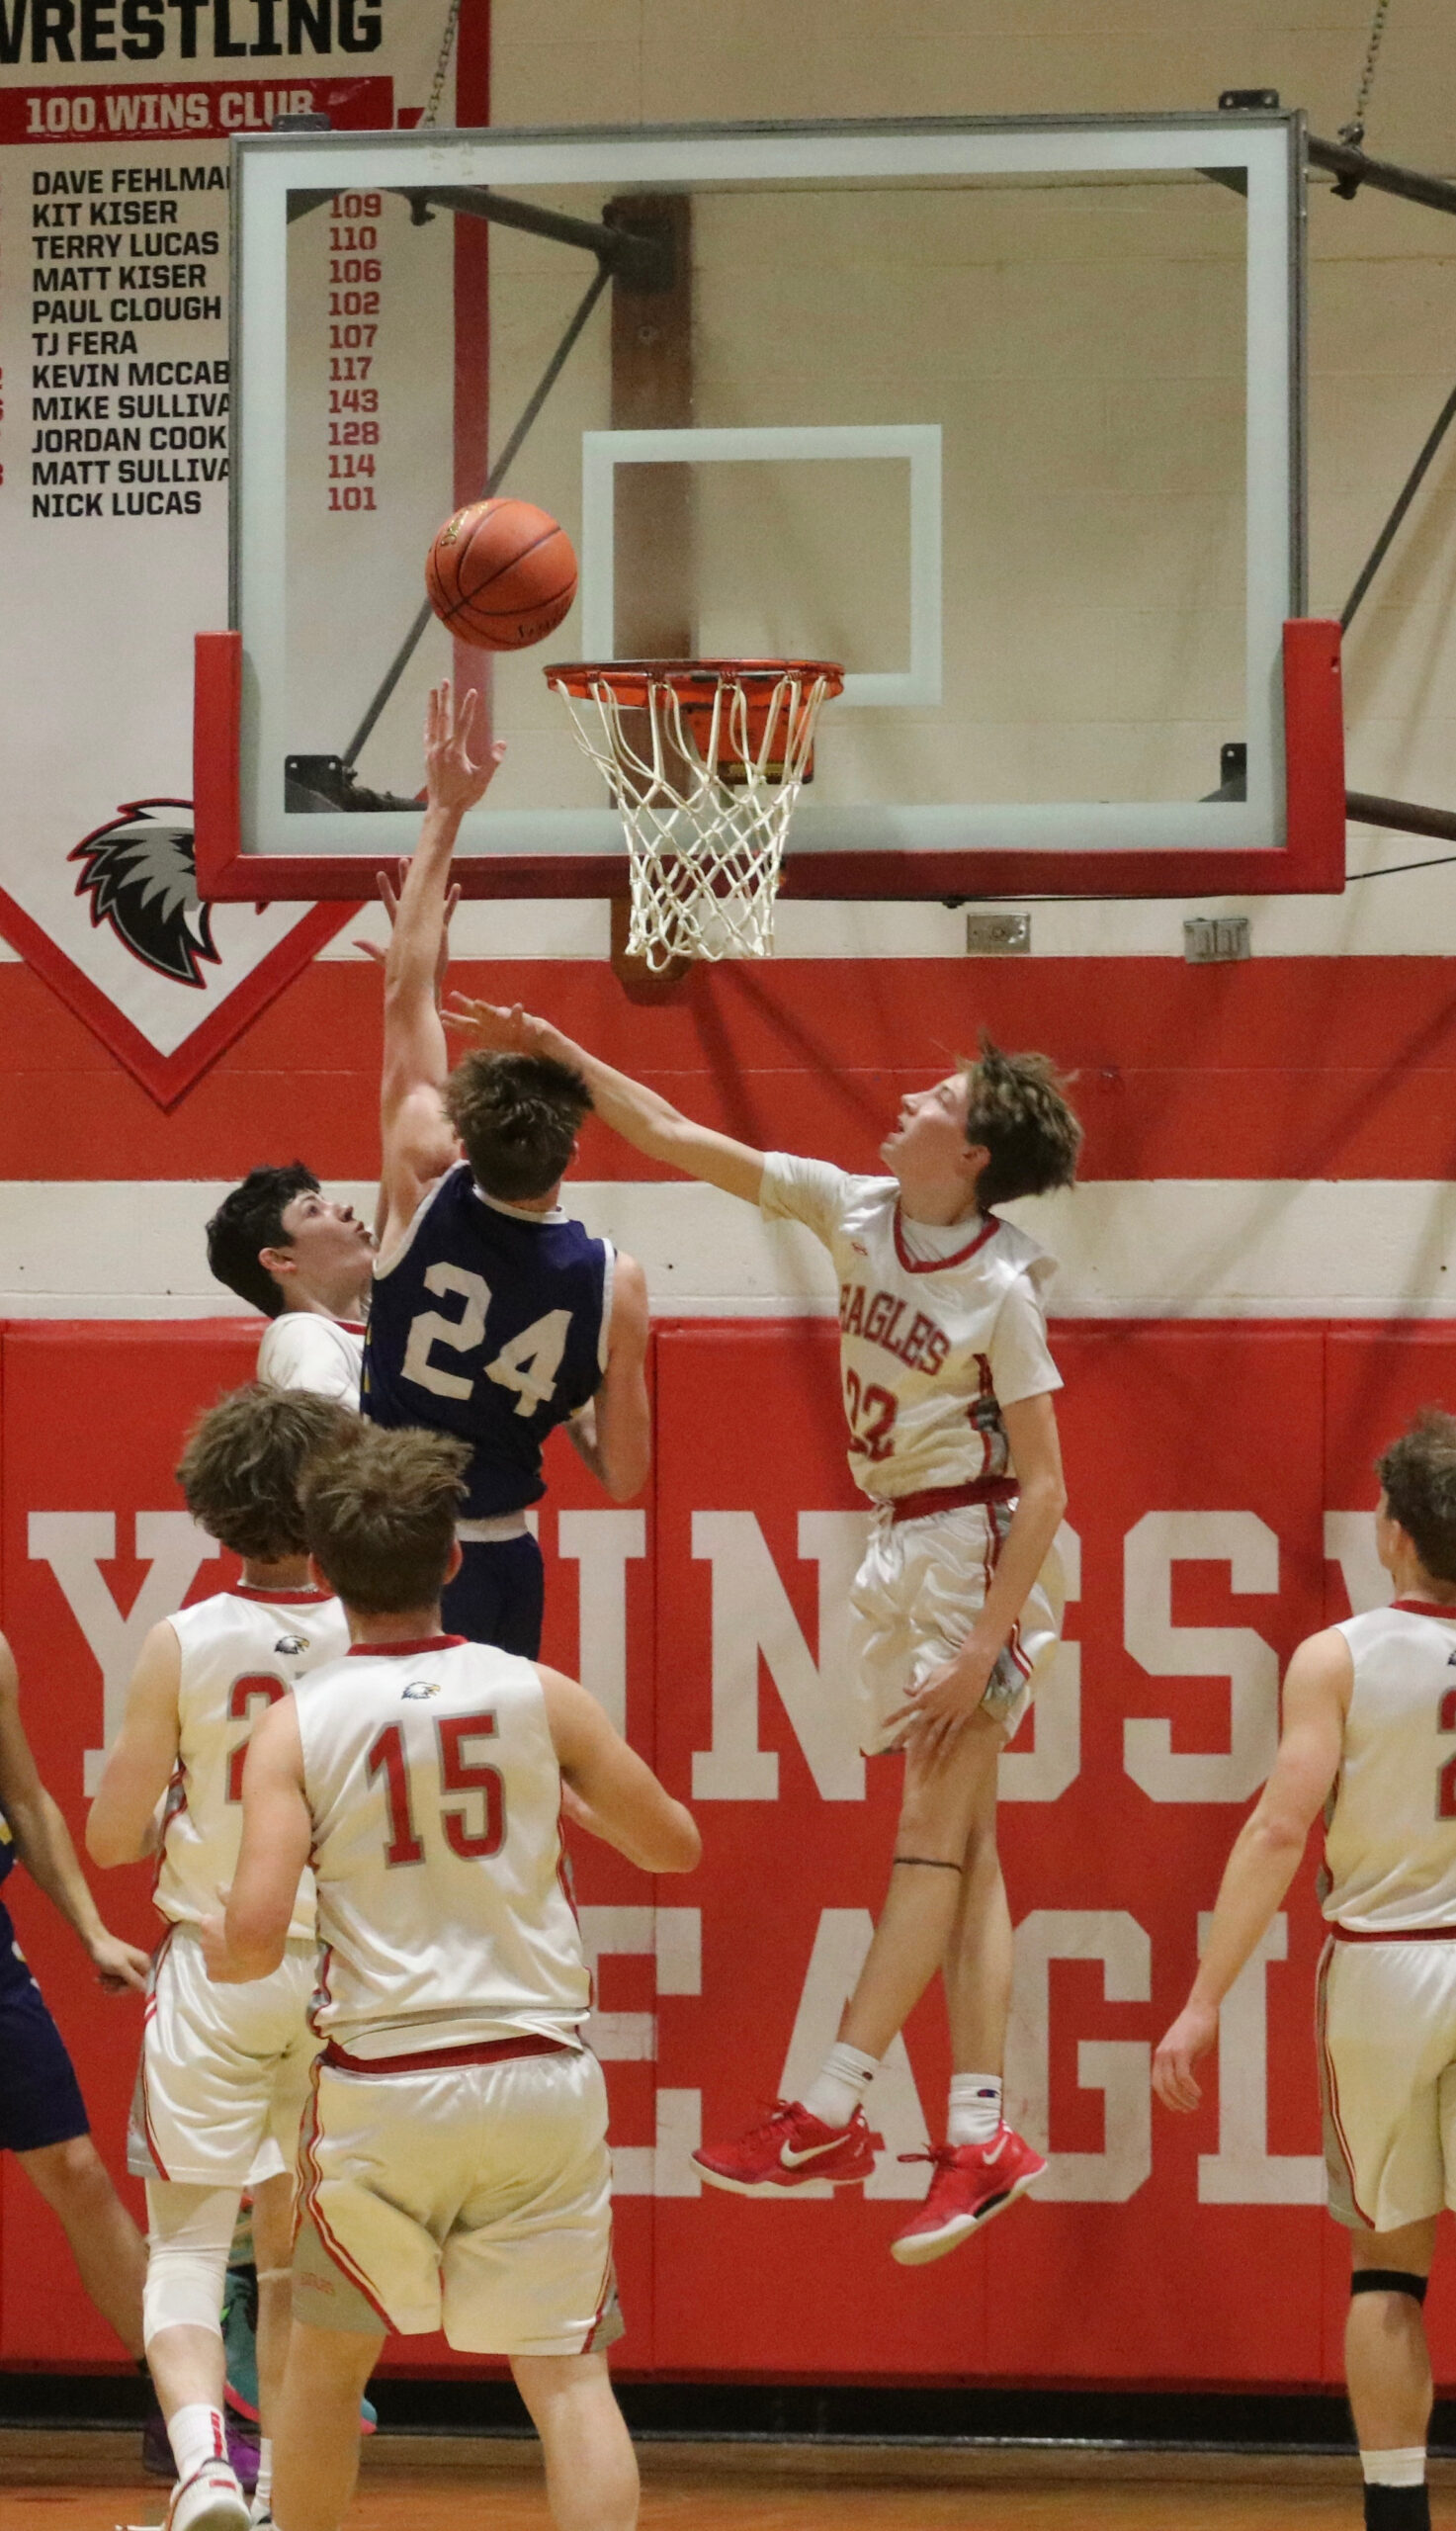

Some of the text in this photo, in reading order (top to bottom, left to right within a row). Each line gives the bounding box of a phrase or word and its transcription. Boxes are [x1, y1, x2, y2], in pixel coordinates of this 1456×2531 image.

[27, 90, 314, 133] 100 WINS CLUB
[33, 166, 229, 195] DAVE FEHLMA
[33, 200, 178, 227] KIT KISER
[329, 194, 382, 218] 109
[32, 231, 218, 259] TERRY LUCAS
[329, 225, 377, 251] 110
[33, 264, 206, 292] MATT KISER
[329, 259, 382, 284] 106
[33, 296, 221, 324] PAUL CLOUGH
[328, 291, 381, 316] 102
[32, 330, 137, 356] TJ FERA
[329, 323, 378, 349] 107
[33, 363, 119, 389] KEVIN
[329, 356, 373, 381] 117
[33, 395, 109, 421] MIKE
[328, 389, 379, 413] 143
[32, 425, 226, 453] JORDAN COOK
[328, 420, 380, 446] 128
[33, 461, 110, 485] MATT
[328, 454, 376, 479] 114
[33, 490, 202, 518] NICK LUCAS
[328, 486, 377, 511] 101
[399, 1261, 574, 1418] 24
[847, 1366, 899, 1462] 22
[366, 1708, 507, 1869] 15
